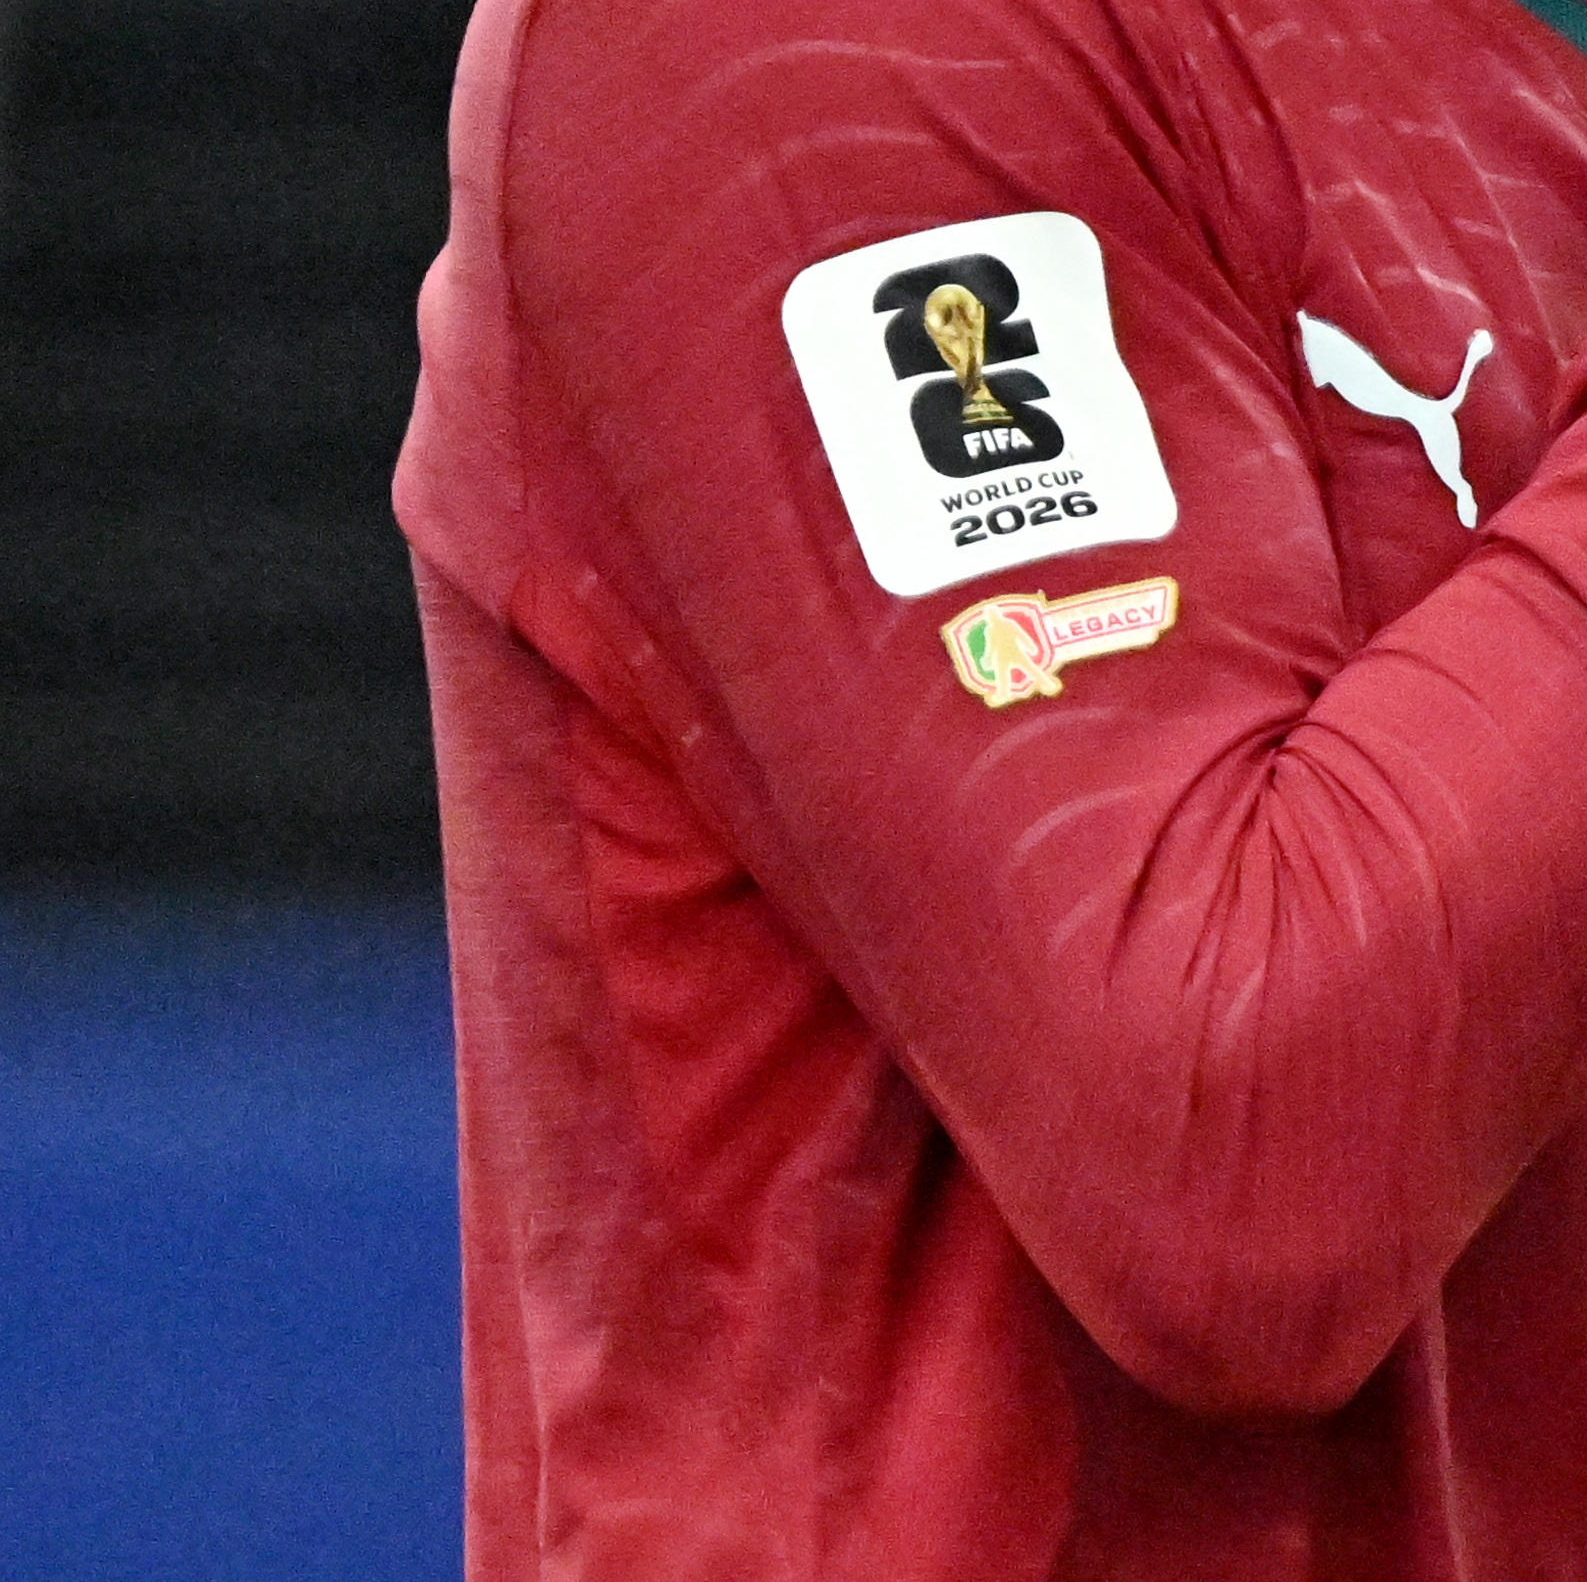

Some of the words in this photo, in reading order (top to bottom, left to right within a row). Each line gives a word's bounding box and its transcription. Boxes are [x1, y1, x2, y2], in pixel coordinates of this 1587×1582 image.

[962, 427, 1034, 459] FIFA
[940, 477, 1033, 513] WORLD
[1037, 469, 1084, 488] CUP
[950, 490, 1098, 548] 2026
[1053, 604, 1157, 641] LEGACY
